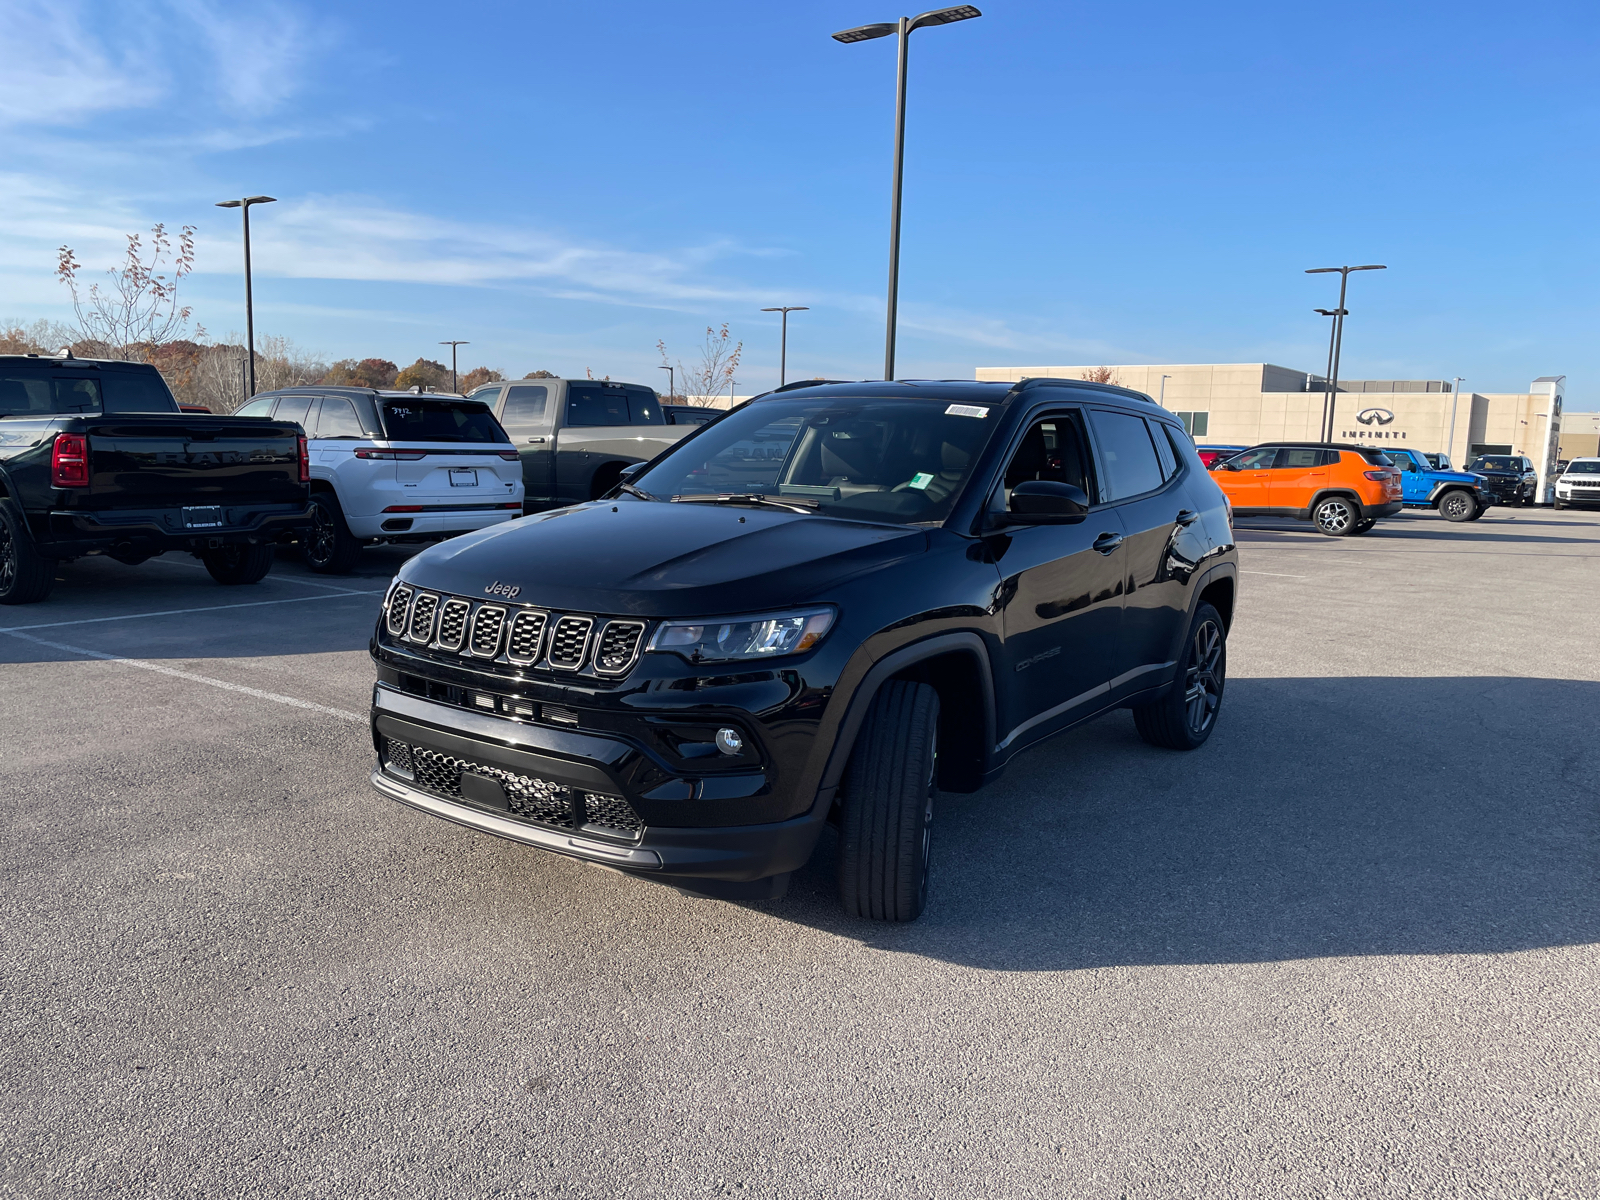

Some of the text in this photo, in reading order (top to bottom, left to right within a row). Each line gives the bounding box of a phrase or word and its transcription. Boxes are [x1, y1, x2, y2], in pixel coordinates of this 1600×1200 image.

[1342, 430, 1407, 439] INFINITI
[156, 452, 251, 464] RAM
[484, 580, 521, 599] Jeep
